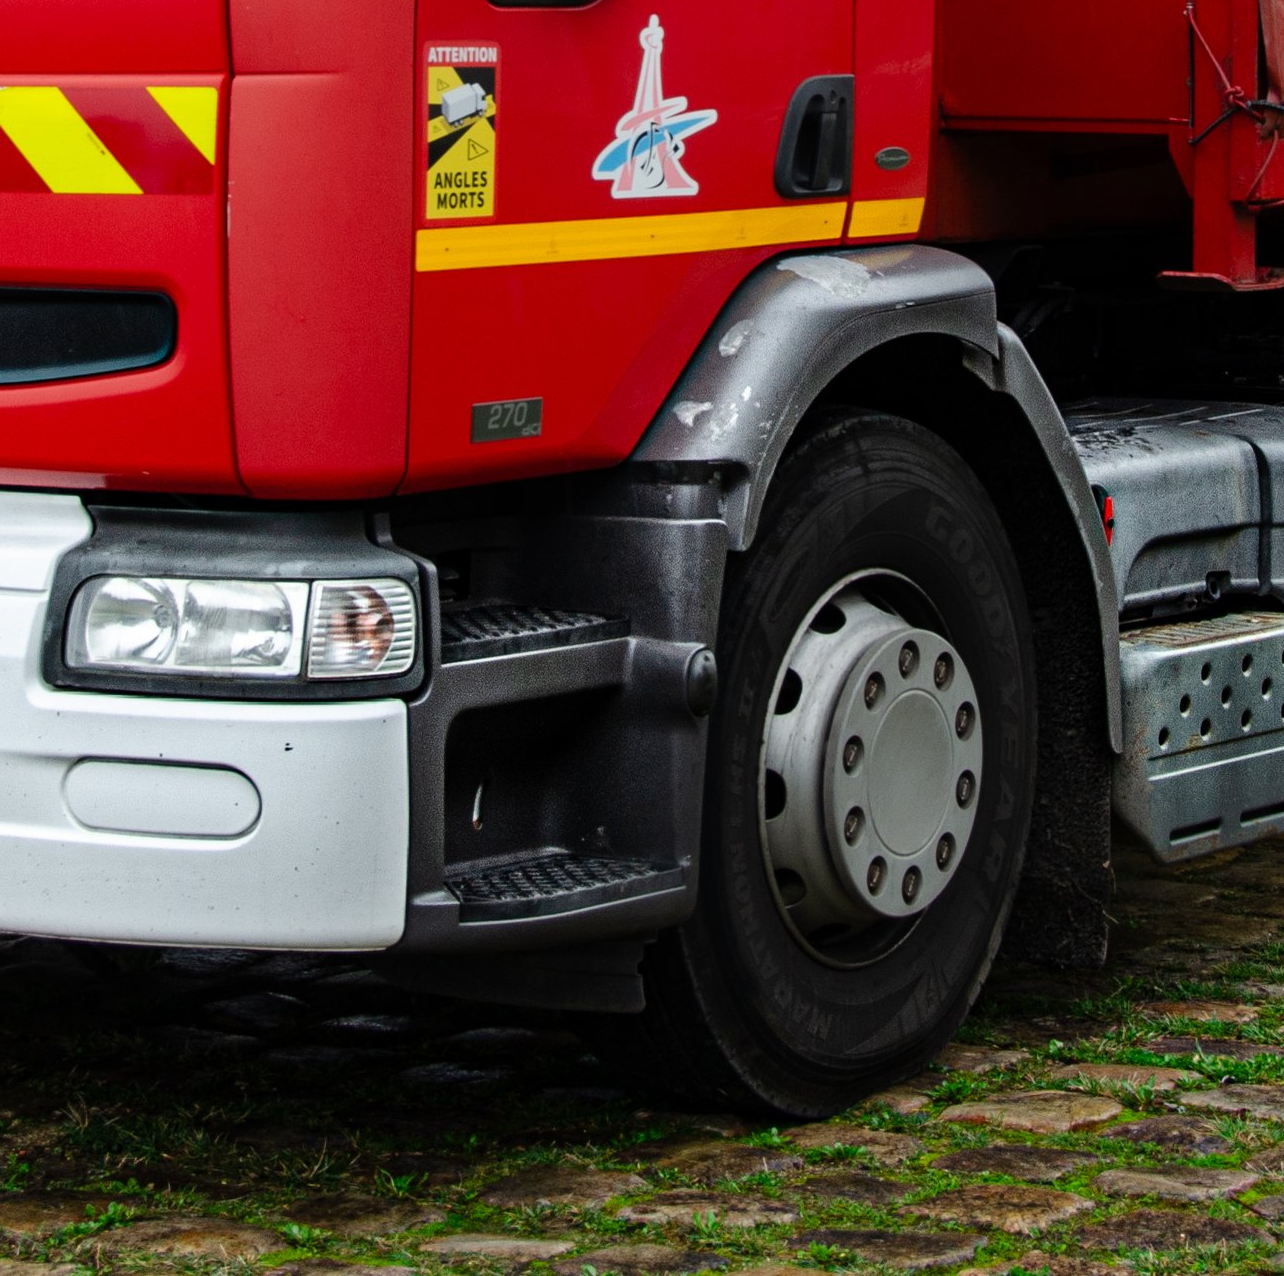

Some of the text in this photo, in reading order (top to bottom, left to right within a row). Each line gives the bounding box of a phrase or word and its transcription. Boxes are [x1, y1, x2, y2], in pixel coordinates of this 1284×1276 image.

[427, 46, 498, 63] ATTENTION
[434, 171, 488, 189] ANGLES
[436, 191, 485, 210] MORTS
[487, 402, 528, 430] 270
[923, 504, 1019, 884] GOODYEAR
